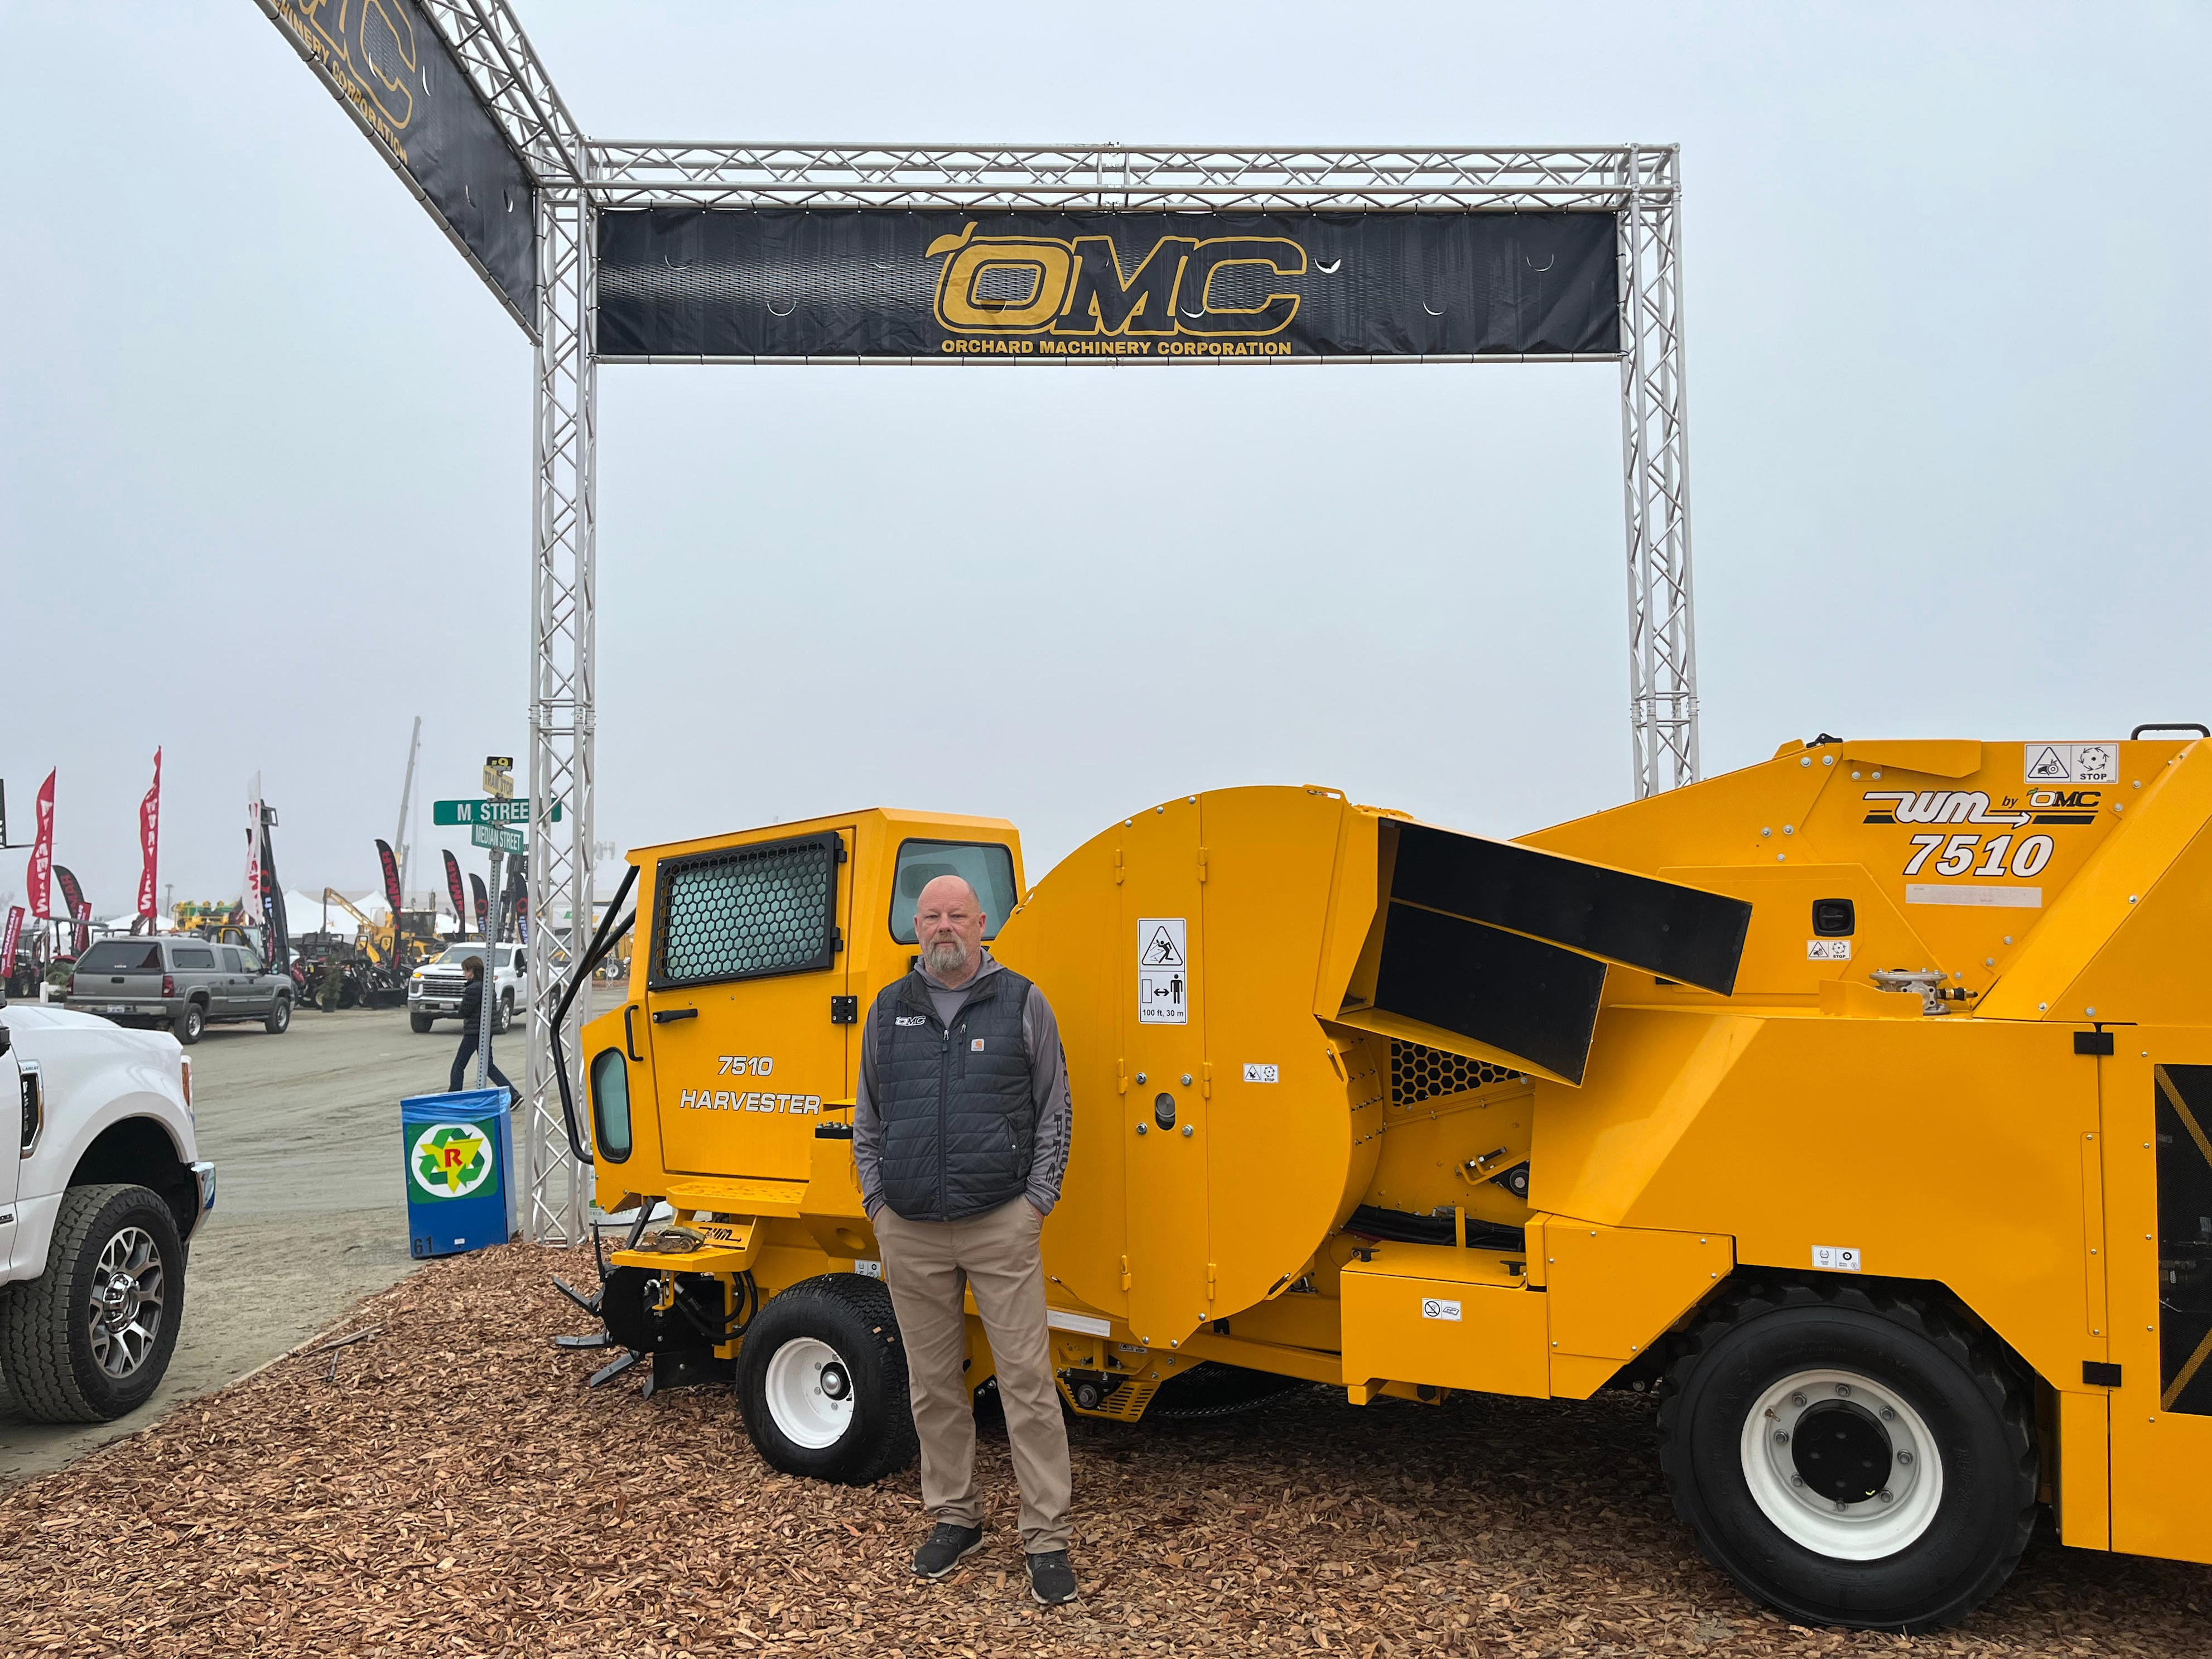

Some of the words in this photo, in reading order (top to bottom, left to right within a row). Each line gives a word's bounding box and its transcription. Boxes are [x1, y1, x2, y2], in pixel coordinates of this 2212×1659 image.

[332, 60, 408, 166] CORPORATION
[931, 230, 1308, 336] OMC
[941, 339, 1034, 354] ORCHARD
[1039, 340, 1151, 355] MACHINERY
[1157, 340, 1291, 355] CORPORATION
[500, 778, 514, 795] STOP
[2002, 796, 2019, 808] by
[2028, 790, 2102, 808] OMC
[457, 803, 471, 821] M
[480, 802, 529, 821] STREE
[475, 824, 498, 847] MEDIAN
[499, 831, 521, 851] STREET
[1902, 833, 2055, 878] 7510
[895, 1015, 926, 1026] OMC
[718, 1055, 774, 1077] 7510
[680, 1089, 821, 1116] HARVESTER
[445, 1149, 463, 1168] R
[414, 1236, 432, 1255] 61
